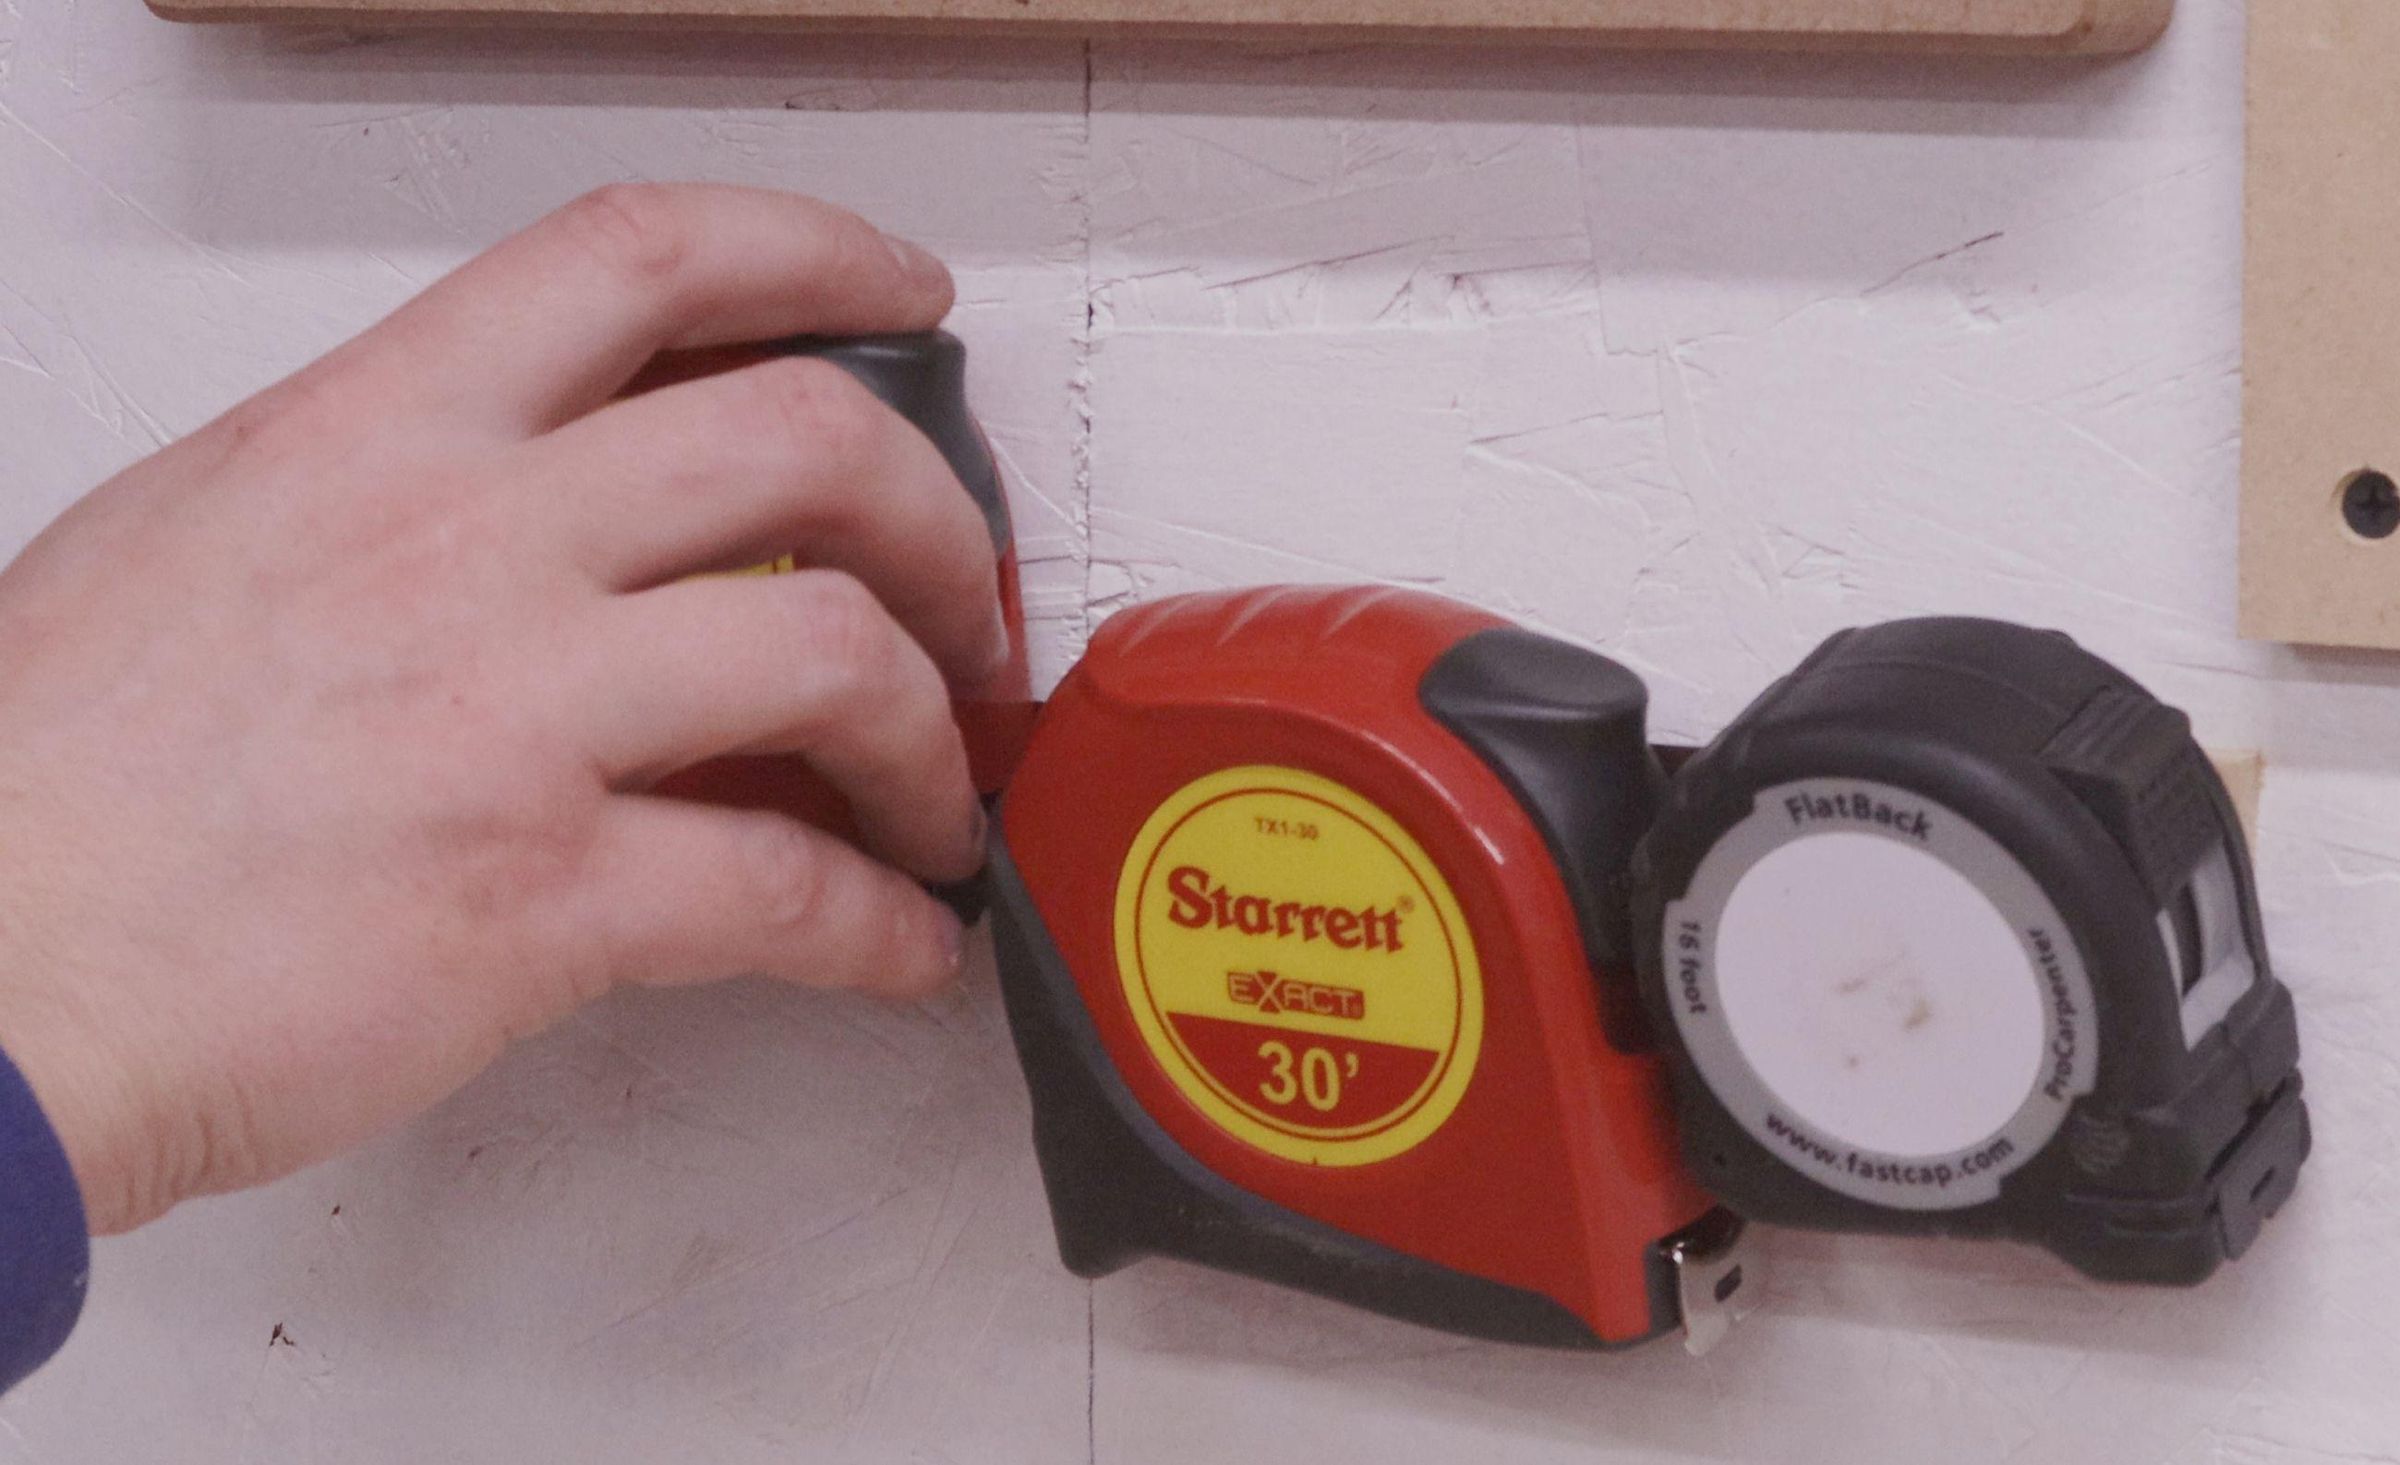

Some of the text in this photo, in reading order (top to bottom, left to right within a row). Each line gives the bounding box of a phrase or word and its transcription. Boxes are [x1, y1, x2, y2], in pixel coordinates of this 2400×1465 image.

[1254, 816, 1320, 841] TX1-30
[1784, 793, 1932, 840] FlatBack
[1167, 866, 1406, 953] Starrett
[1227, 970, 1364, 1020] EXACT
[1679, 921, 1707, 1014] 16 foot
[2027, 927, 2079, 1101] ProCarpenter
[1257, 1040, 1360, 1112] 30'
[1765, 1112, 2016, 1187] www.fastcap.com
